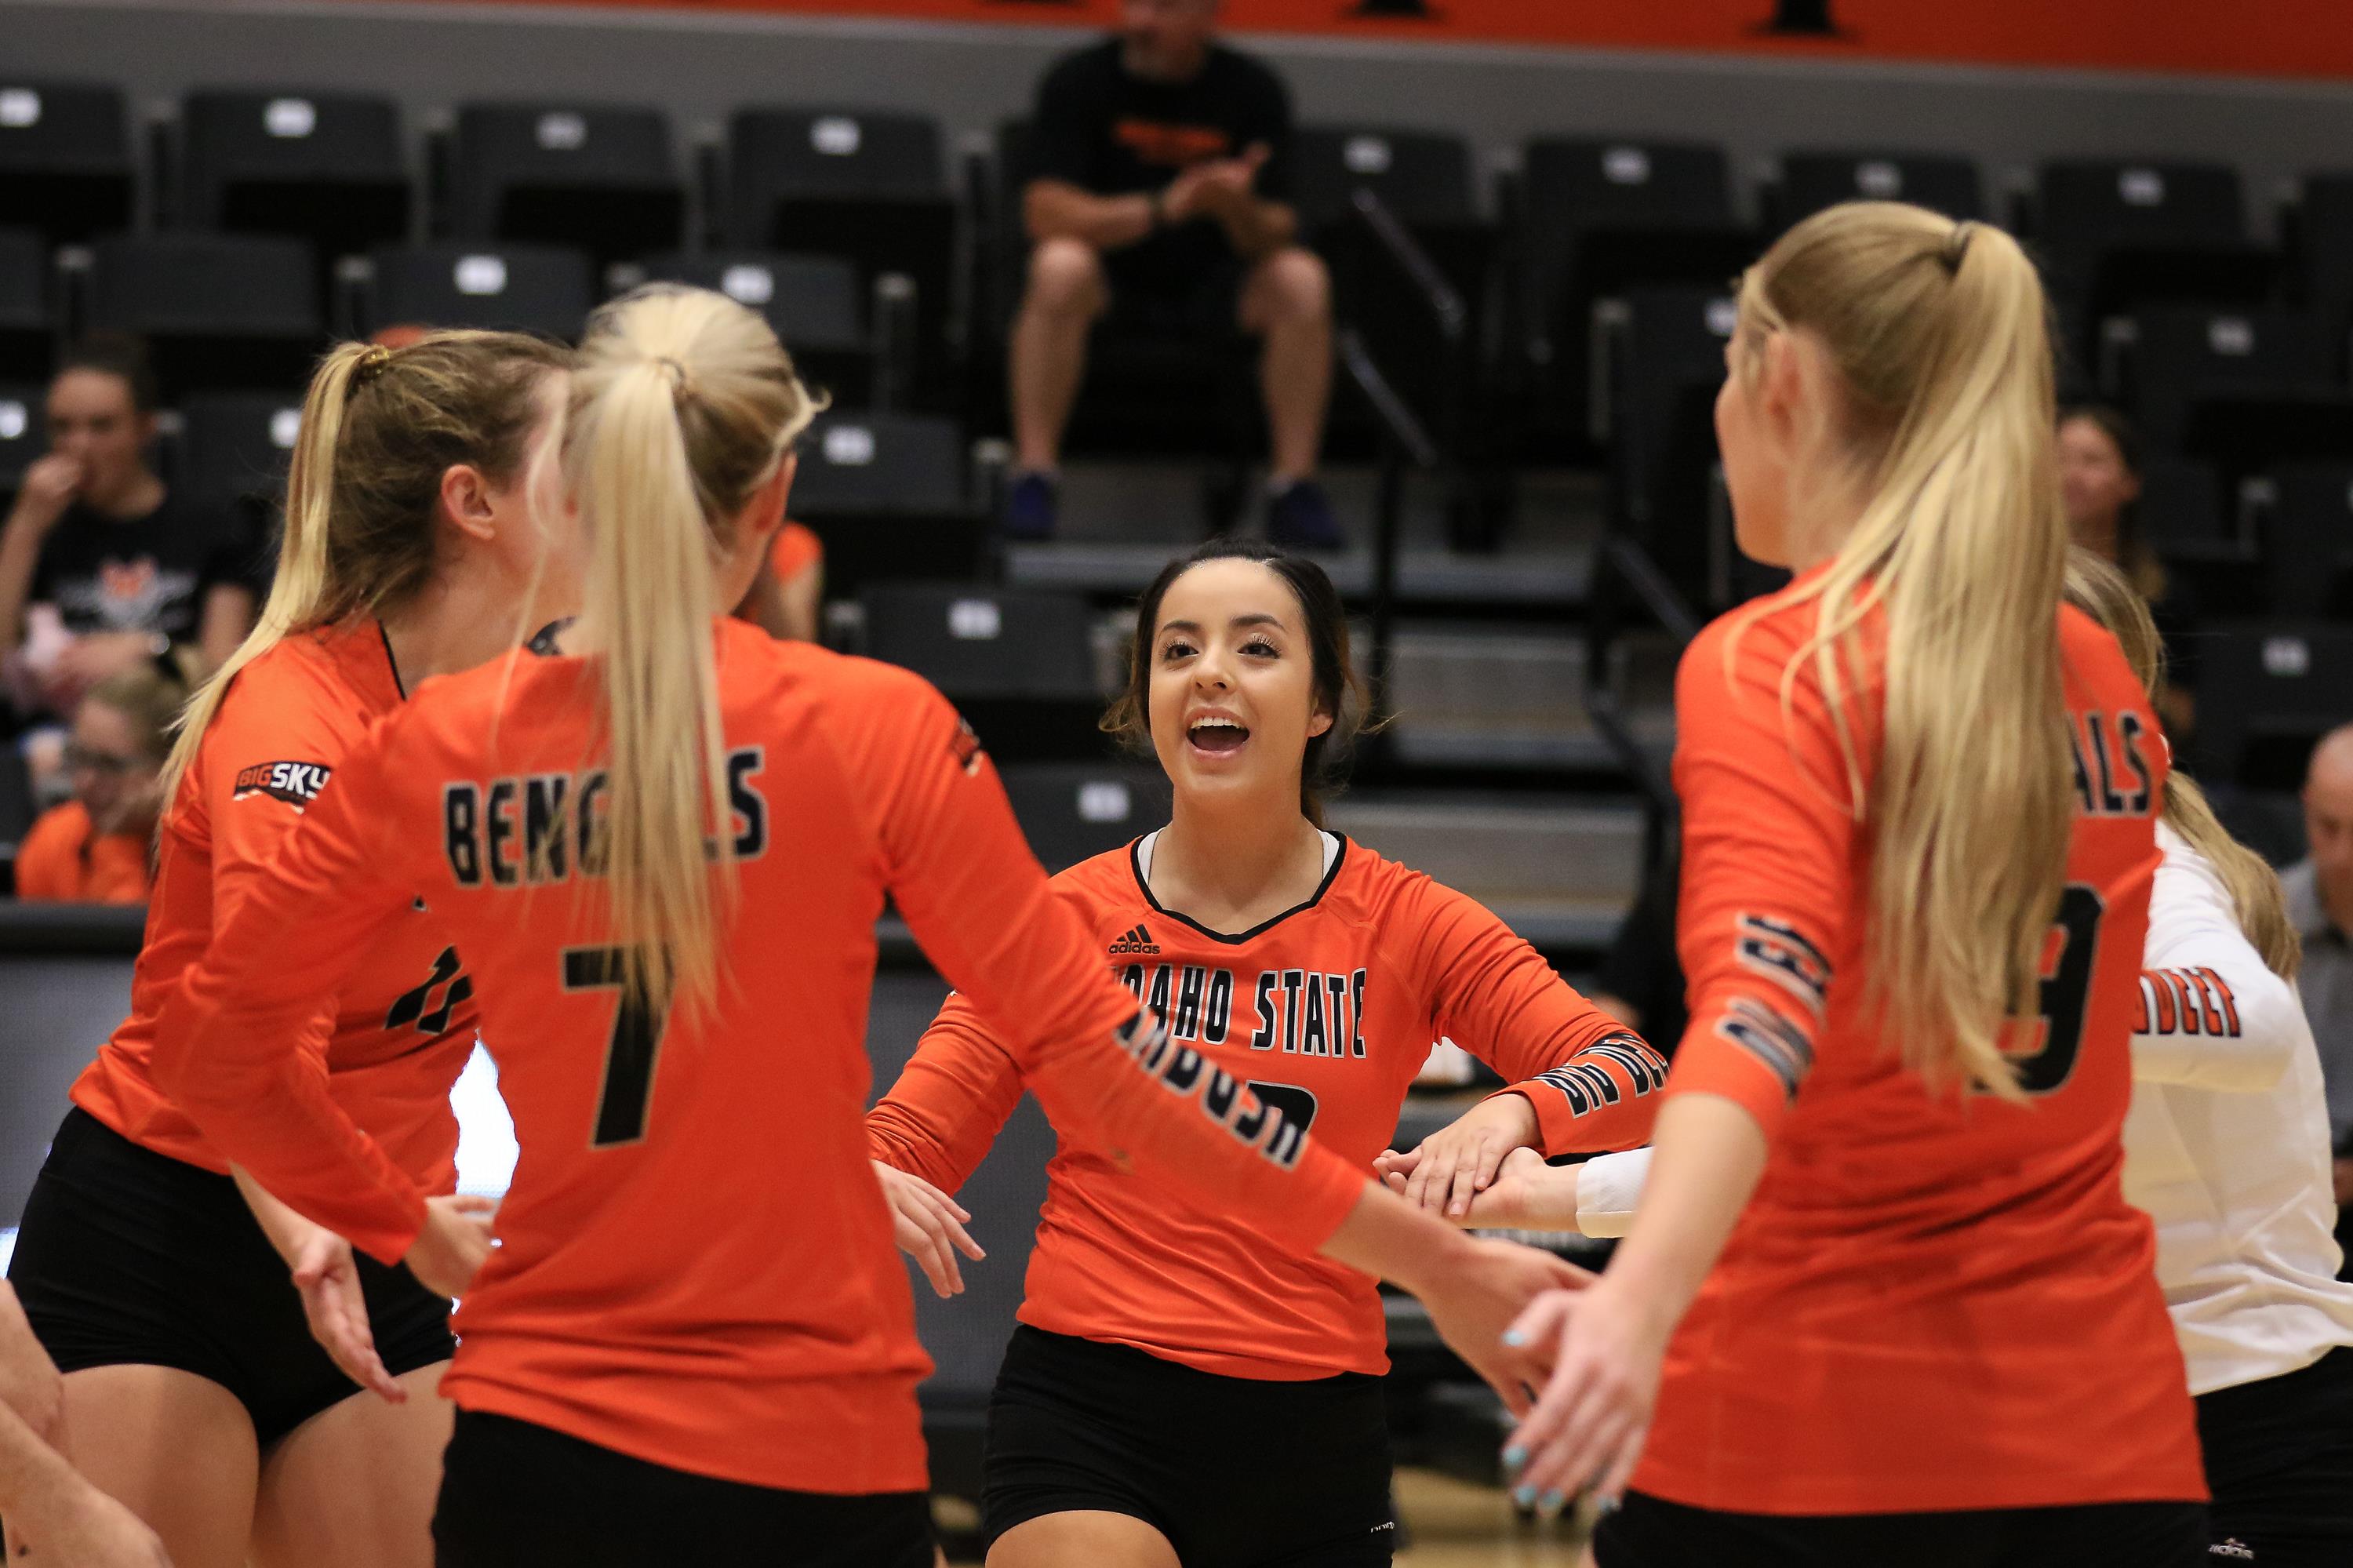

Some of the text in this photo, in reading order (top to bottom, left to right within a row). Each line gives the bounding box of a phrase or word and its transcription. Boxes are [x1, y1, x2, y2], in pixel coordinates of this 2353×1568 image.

[237, 762, 330, 800] BIG SKY
[442, 742, 770, 890] BENGS
[1108, 940, 1161, 955] adidas
[558, 944, 676, 1150] 7
[1249, 967, 1367, 1060] STATE
